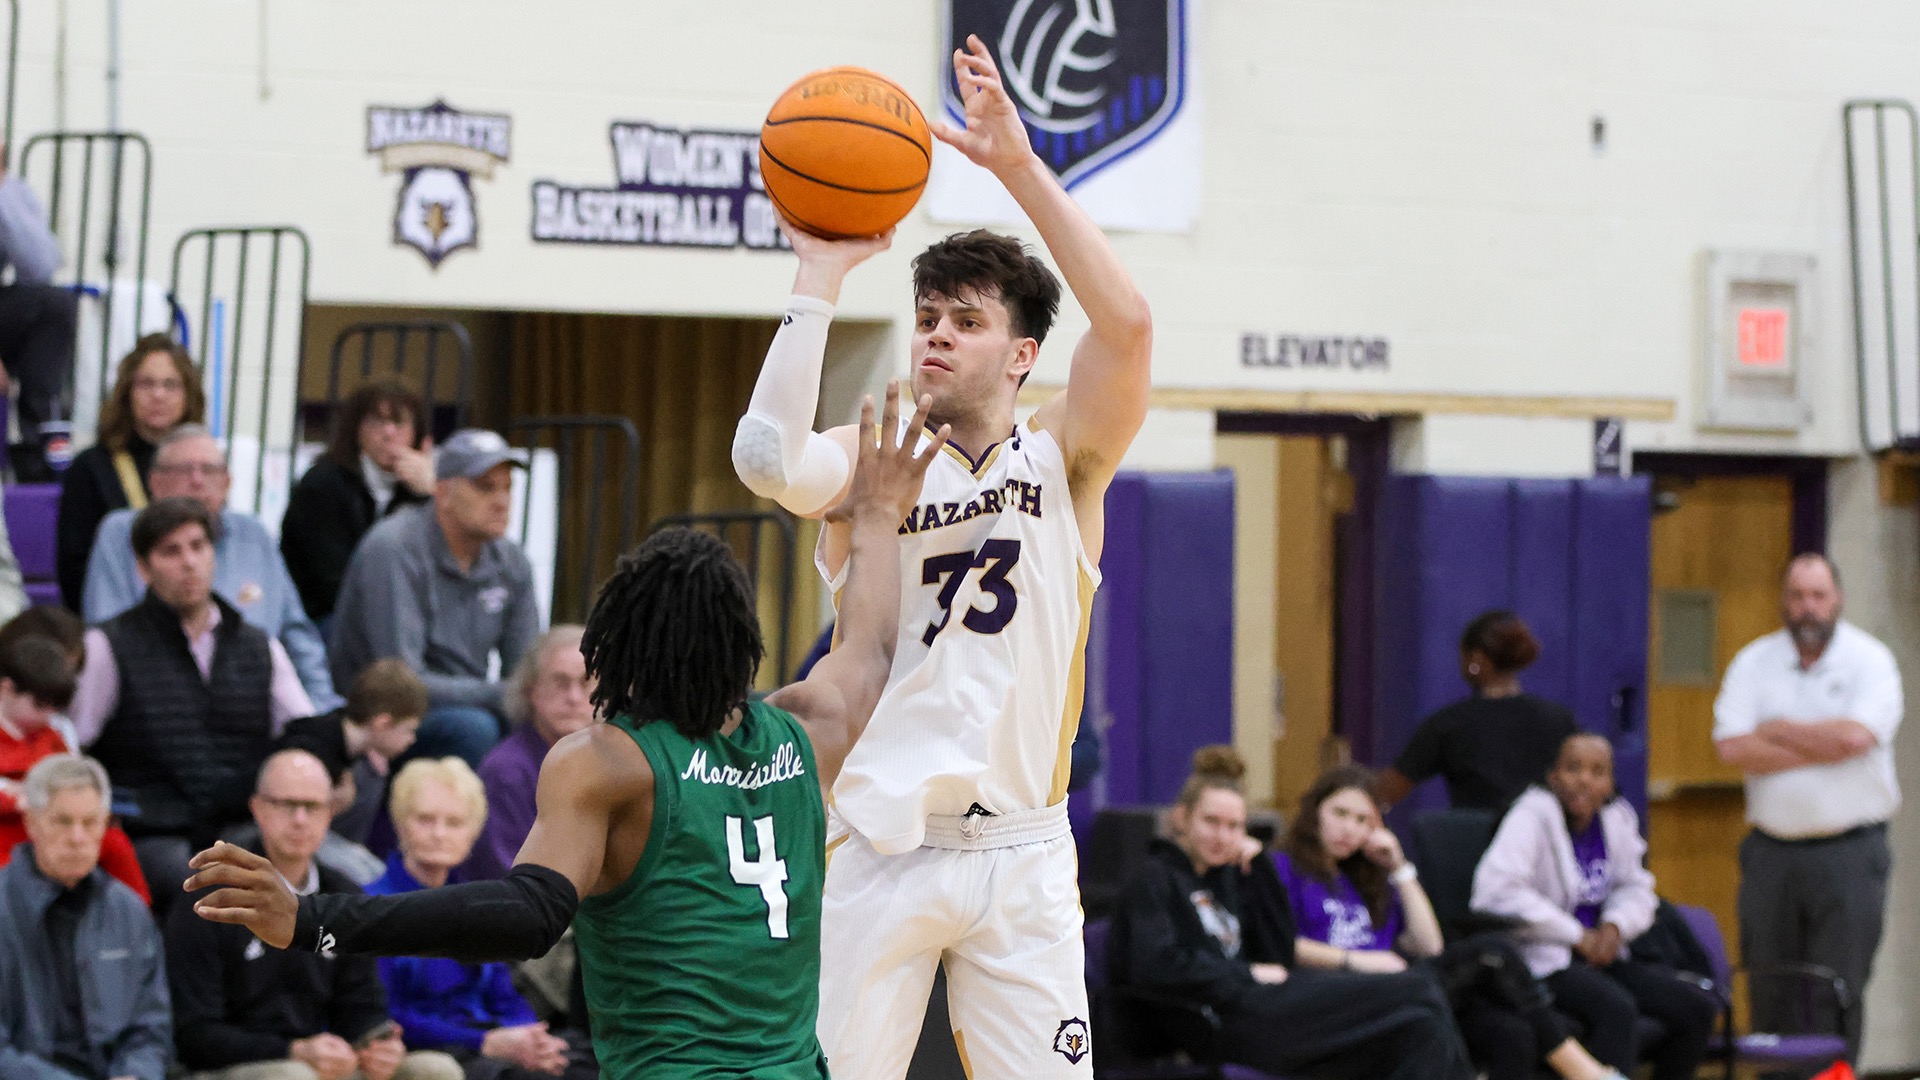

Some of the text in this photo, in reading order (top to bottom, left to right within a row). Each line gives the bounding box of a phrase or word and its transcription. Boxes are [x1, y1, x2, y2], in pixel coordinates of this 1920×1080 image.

[534, 183, 739, 246] BASKETBALL
[1240, 334, 1390, 369] ELEVATOR
[1738, 308, 1788, 365] EXIT
[898, 478, 1042, 536] NAZARTH
[921, 538, 1022, 648] 33
[726, 814, 789, 939] 4
